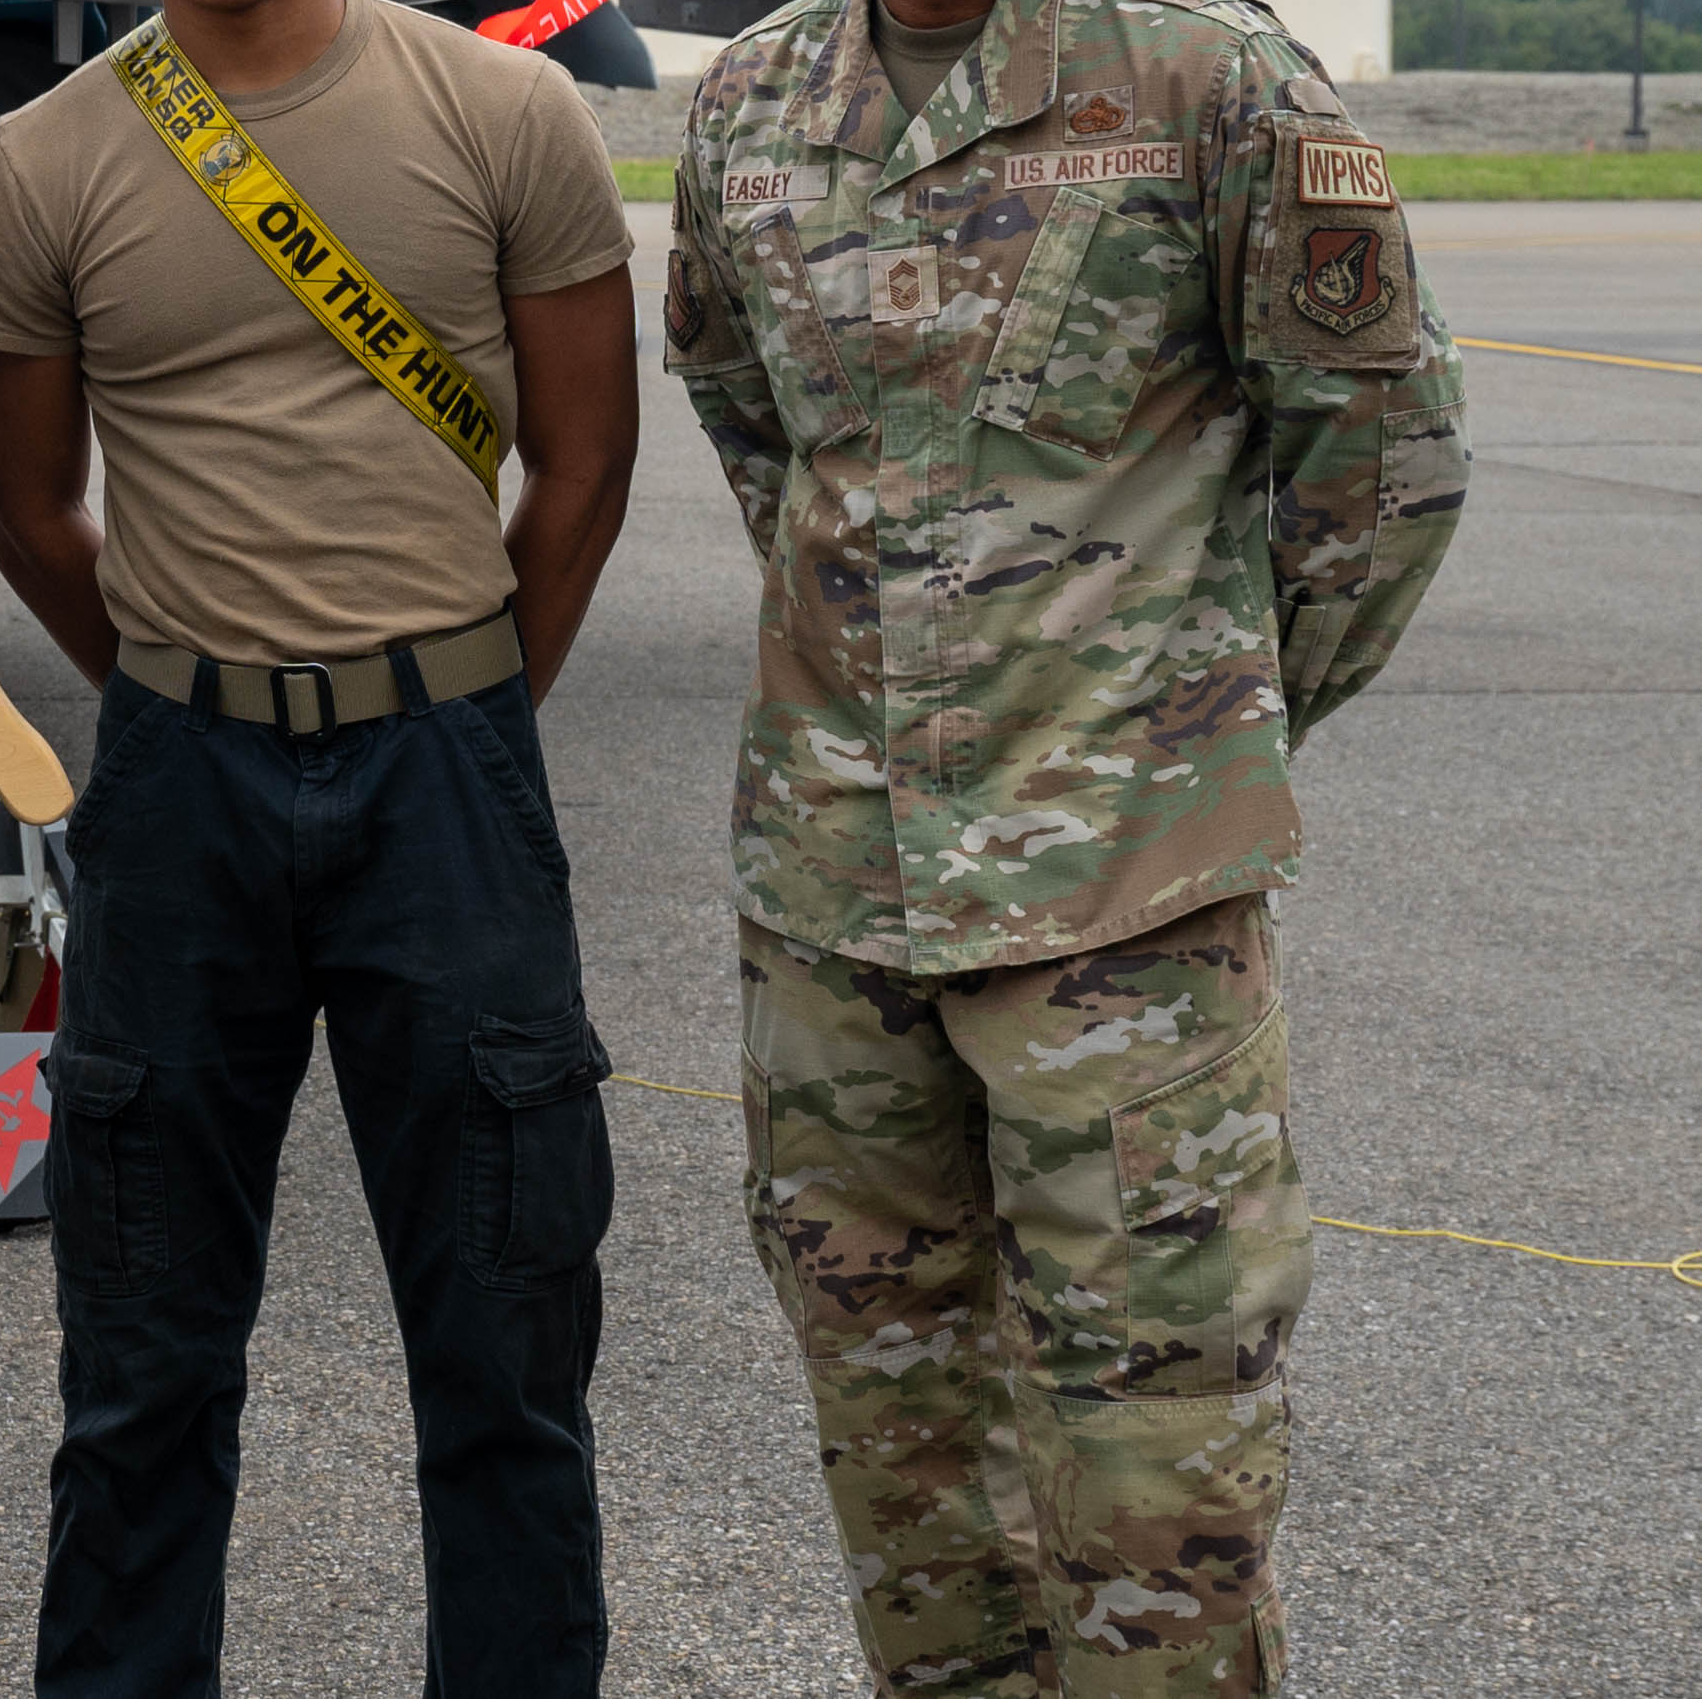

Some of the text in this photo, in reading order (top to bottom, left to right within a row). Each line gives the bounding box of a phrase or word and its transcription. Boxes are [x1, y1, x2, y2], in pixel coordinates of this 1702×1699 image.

[155, 99, 193, 143] SQ
[1055, 154, 1095, 180] AIR
[1102, 147, 1178, 177] FORCE
[1307, 148, 1383, 197] WPNS
[726, 172, 792, 201] EASLEY
[257, 201, 494, 454] ON THE HUNT
